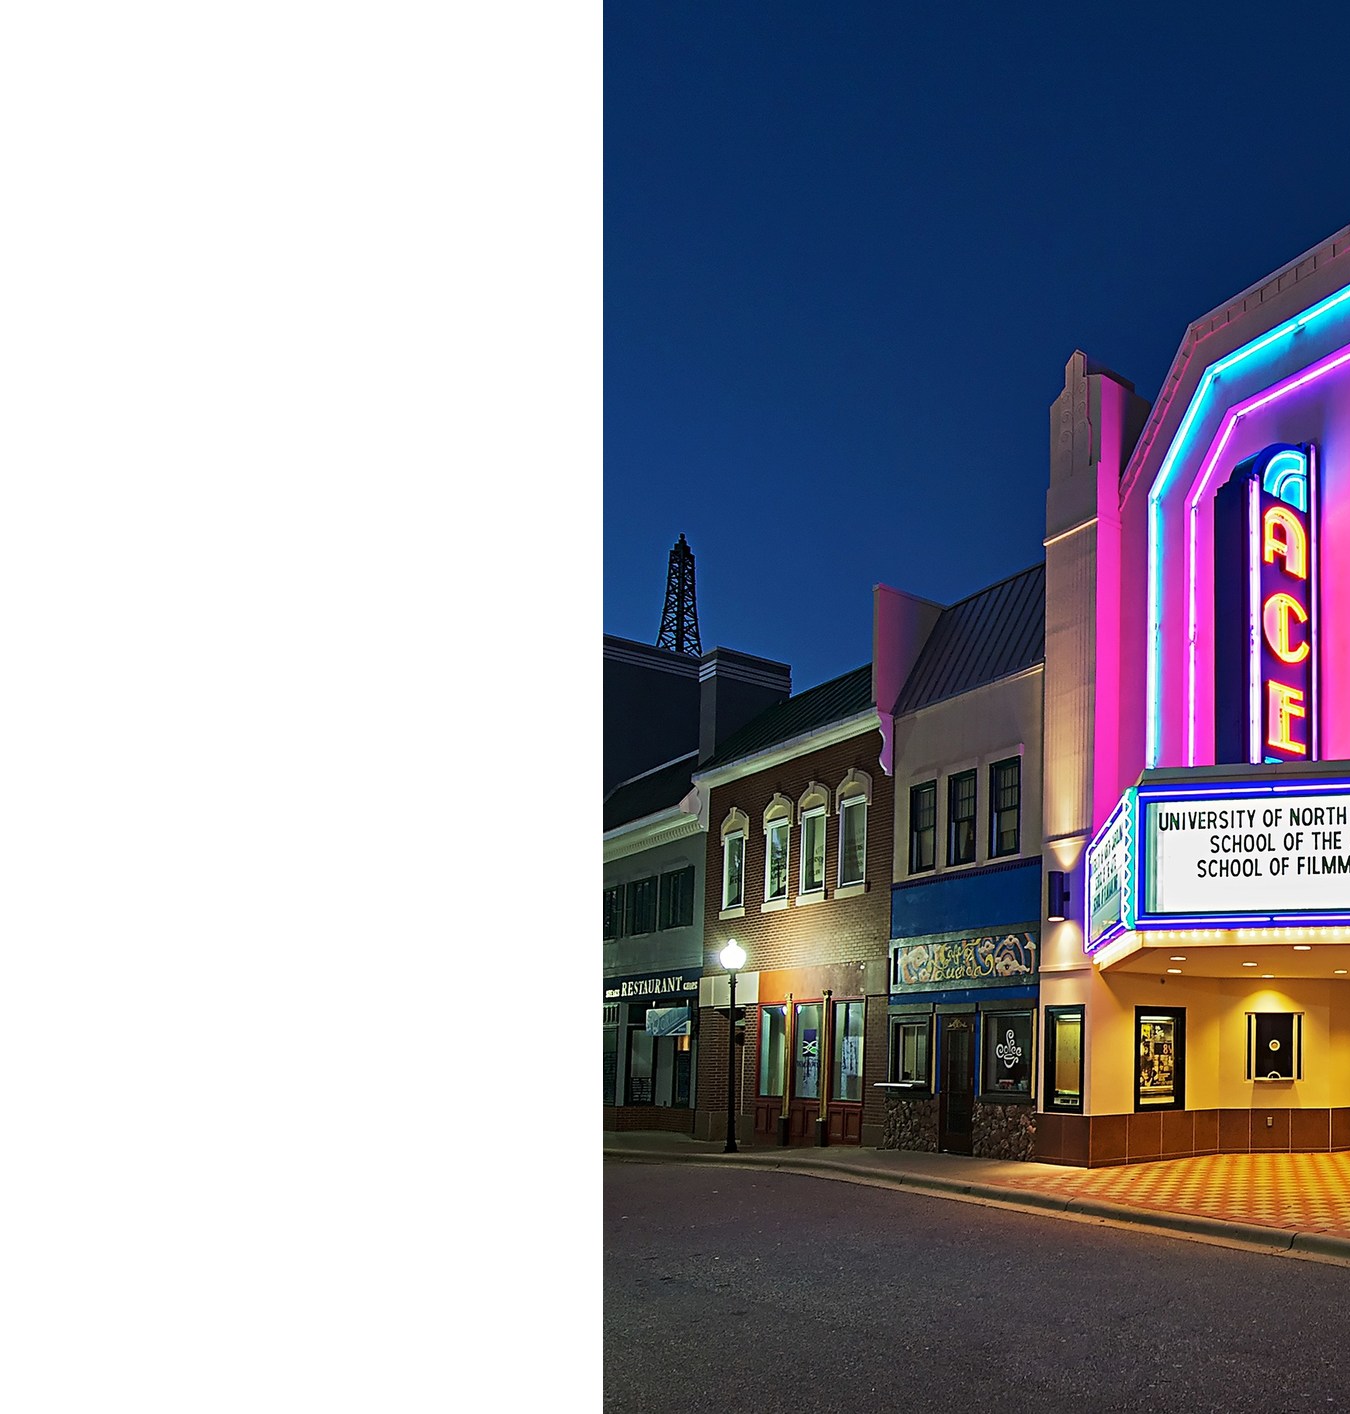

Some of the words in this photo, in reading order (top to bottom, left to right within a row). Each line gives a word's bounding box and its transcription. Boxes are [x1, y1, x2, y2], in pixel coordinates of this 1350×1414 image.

[1159, 809, 1256, 831] UNIVERSITY
[1262, 808, 1283, 828] OF
[1289, 806, 1347, 827] NORTH
[1210, 833, 1276, 853] SCHOOL
[1283, 832, 1304, 851] OF
[1311, 831, 1342, 850] THE
[1197, 858, 1263, 878] SCHOOL
[1269, 857, 1290, 876] OF
[621, 976, 683, 997] RESTAURANT
